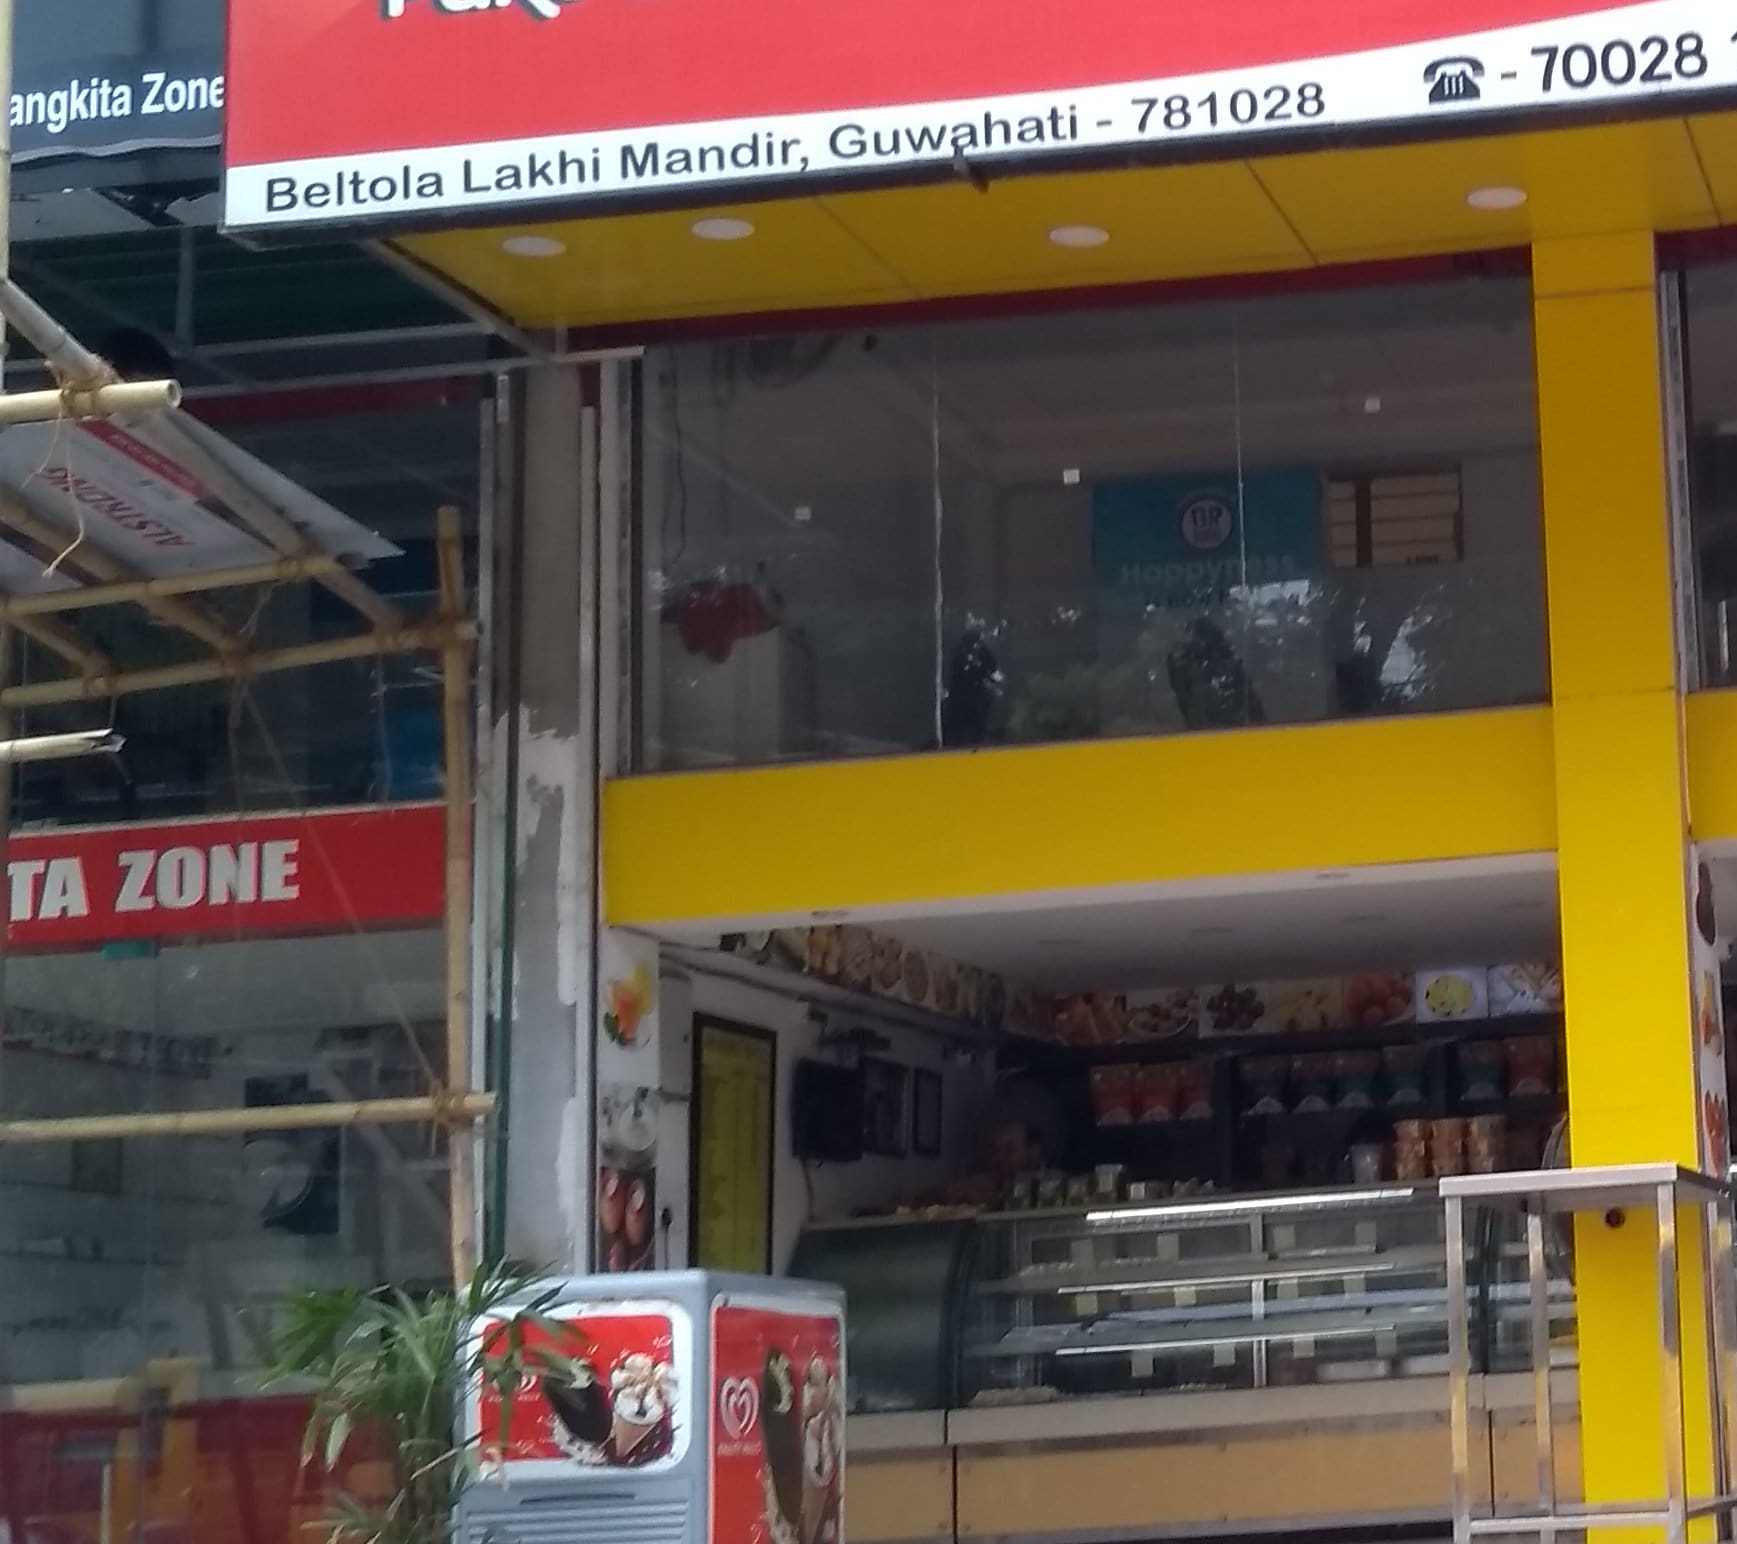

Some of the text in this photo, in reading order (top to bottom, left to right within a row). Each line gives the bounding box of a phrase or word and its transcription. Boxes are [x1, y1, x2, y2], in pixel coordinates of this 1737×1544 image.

[10, 72, 224, 134] angkita Zone
[265, 164, 444, 213] Beltola
[462, 148, 601, 194] Lakhi
[619, 131, 810, 173] Mandir,
[829, 104, 1079, 158] Guwahati
[1131, 82, 1326, 134] 781028
[1530, 30, 1708, 92] 70028
[116, 839, 300, 913] ZONE
